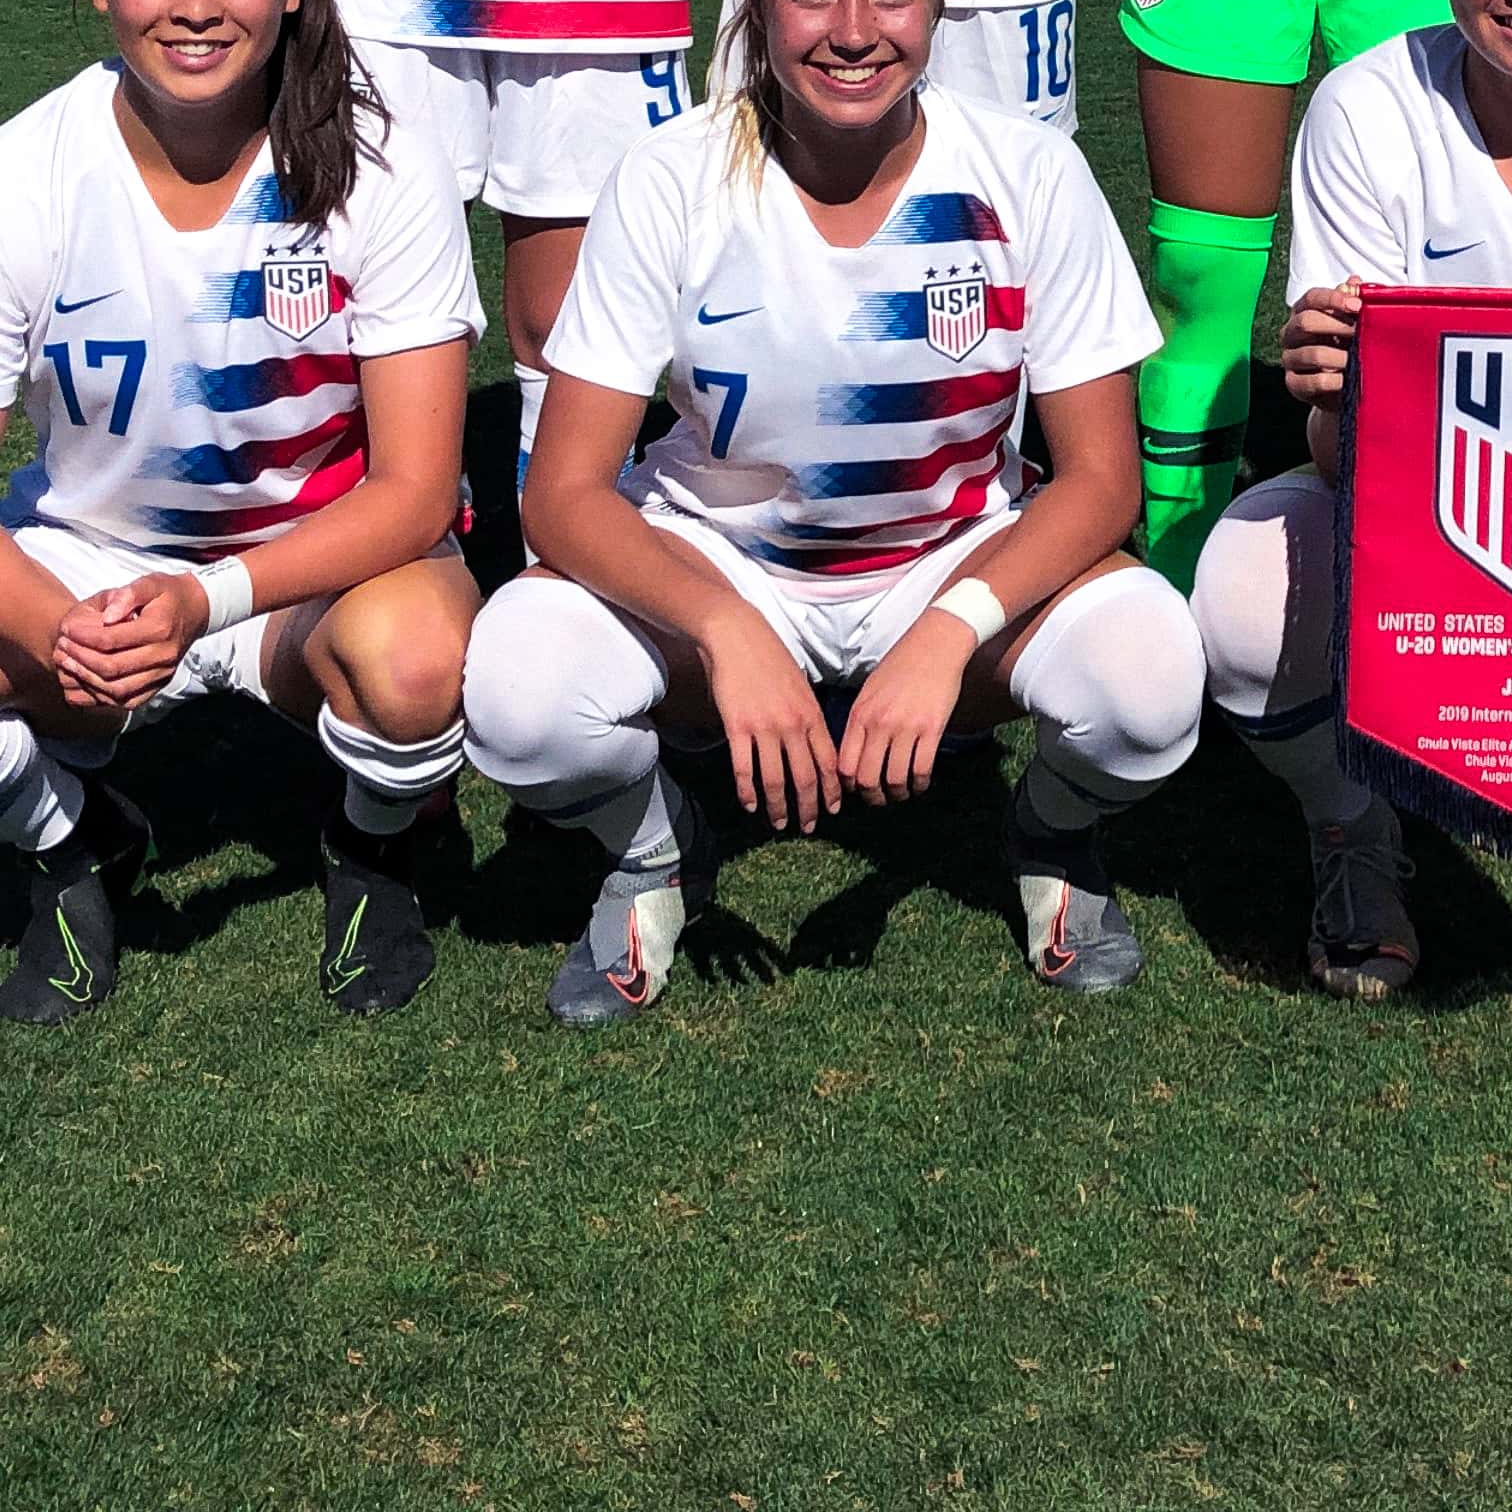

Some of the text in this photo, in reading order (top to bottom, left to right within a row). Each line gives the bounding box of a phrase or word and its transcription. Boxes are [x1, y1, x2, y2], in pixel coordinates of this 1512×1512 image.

[1019, 0, 1073, 102] 10
[640, 50, 682, 128] 9
[268, 268, 323, 294] USA
[931, 286, 980, 315] USA
[43, 340, 147, 436] 17
[692, 367, 748, 460] 7
[1377, 612, 1435, 632] UNITED
[1444, 614, 1505, 634] STATES
[1396, 636, 1435, 655] U-20
[1438, 705, 1470, 722] 2019
[1417, 737, 1450, 751] Chula
[1451, 738, 1481, 752] Vista
[1481, 738, 1507, 752] Elite
[1465, 754, 1497, 768] Chula
